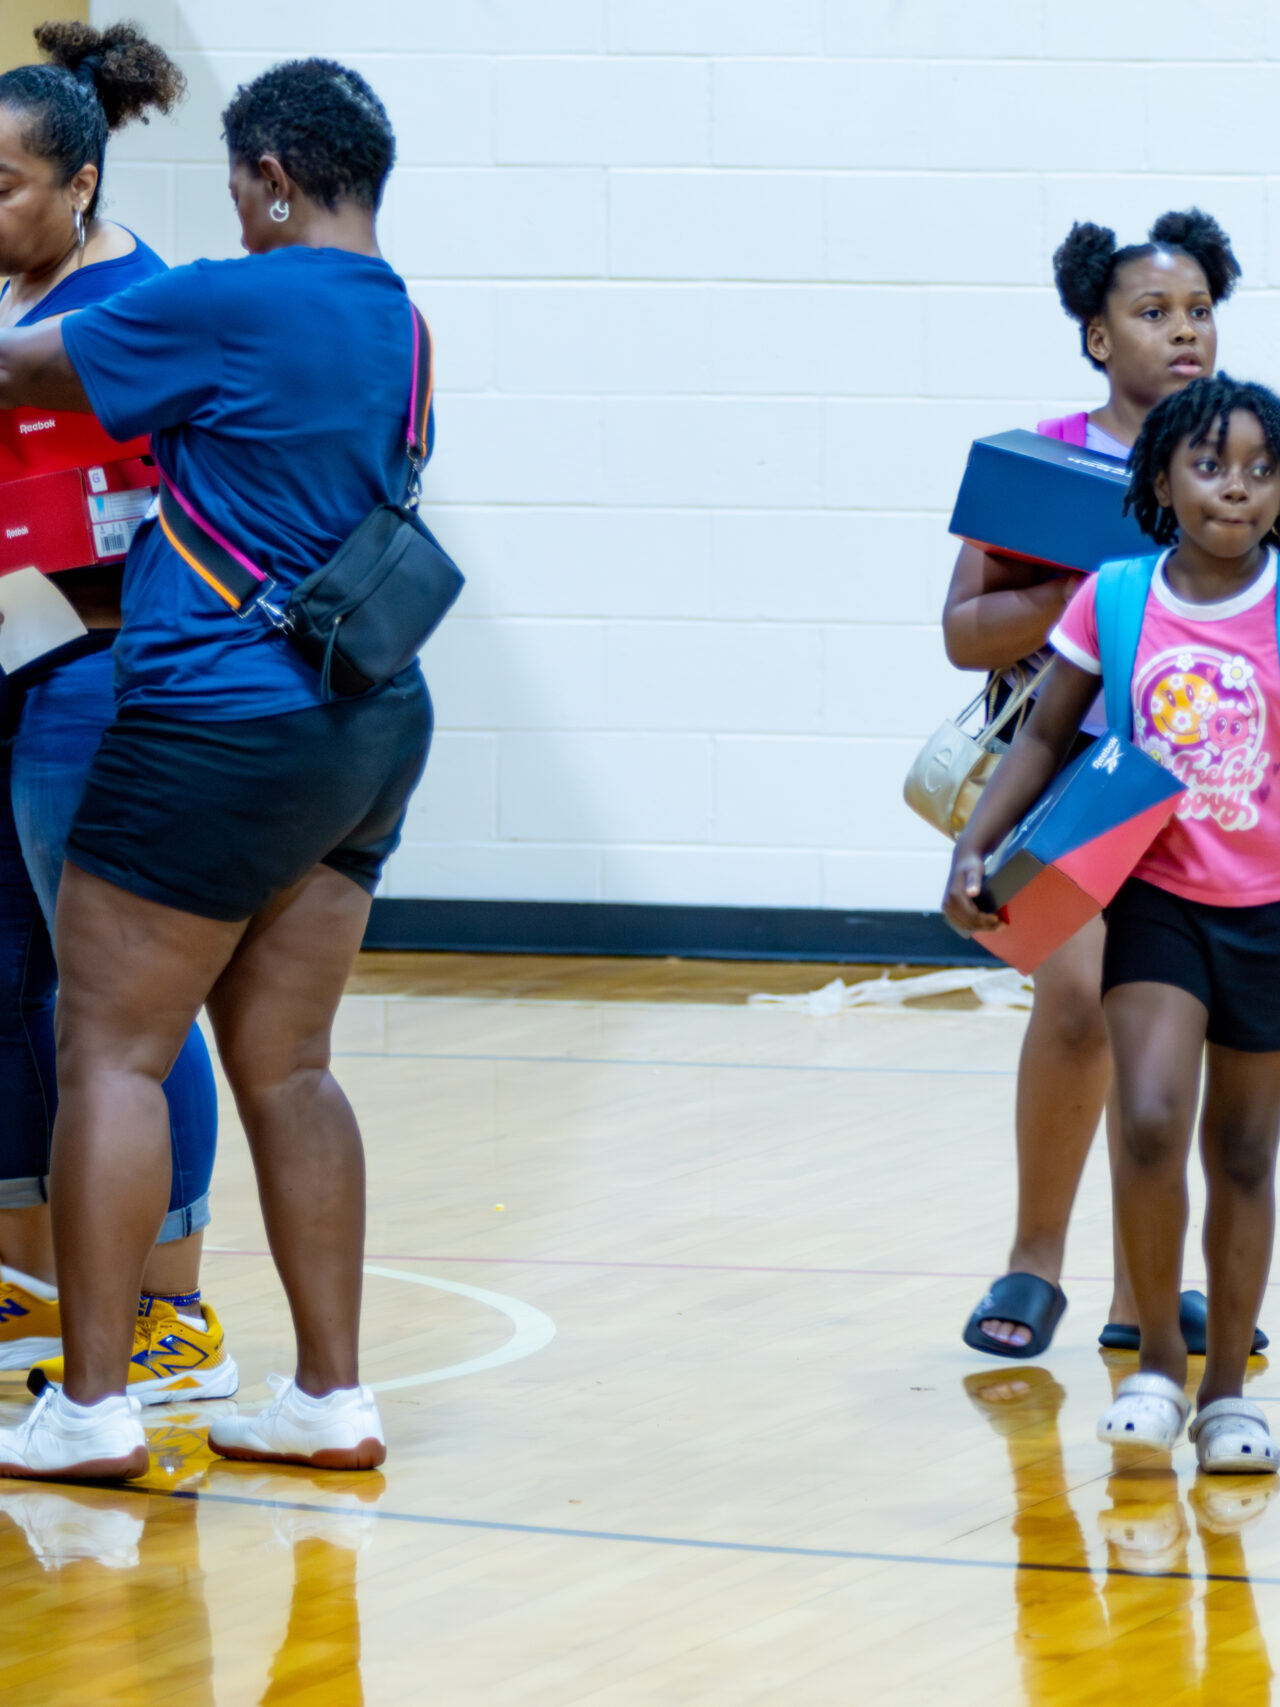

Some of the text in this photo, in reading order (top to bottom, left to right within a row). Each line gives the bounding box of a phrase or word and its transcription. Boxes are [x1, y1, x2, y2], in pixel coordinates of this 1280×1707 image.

[19, 419, 56, 434] Reebok
[92, 473, 101, 484] G
[1091, 736, 1119, 770] Reebok
